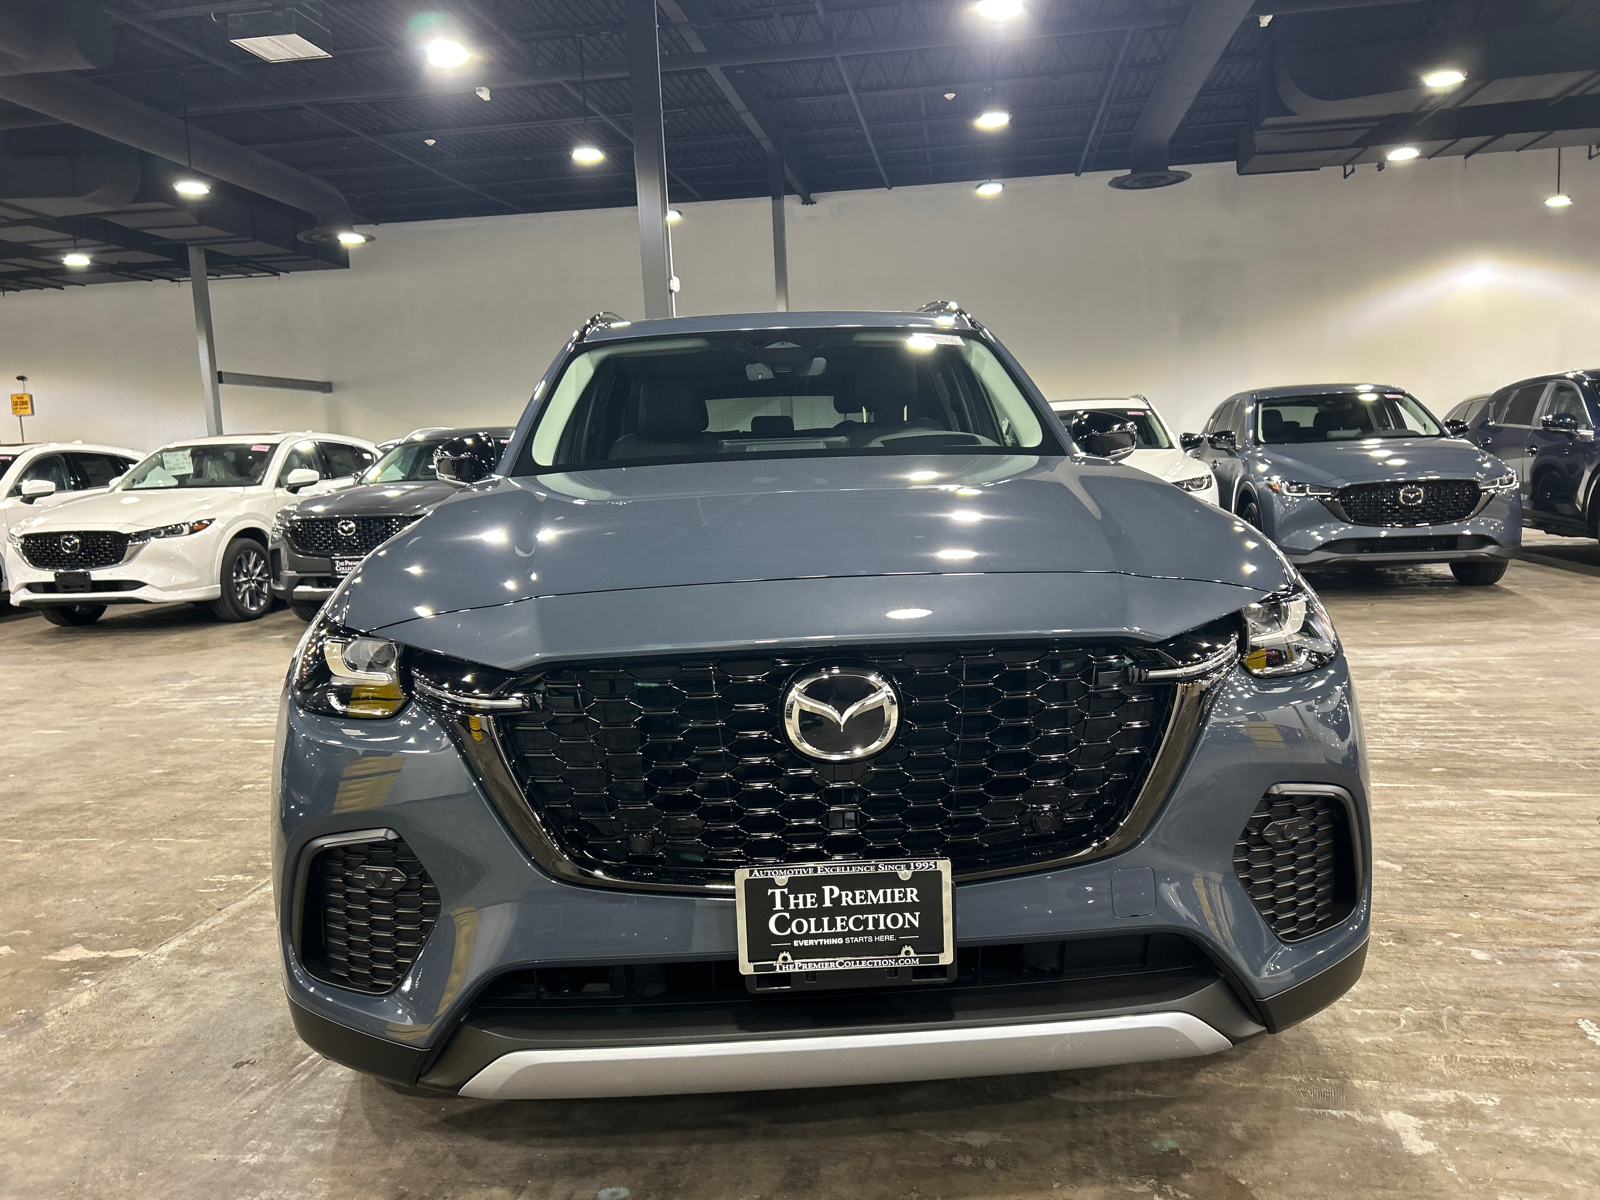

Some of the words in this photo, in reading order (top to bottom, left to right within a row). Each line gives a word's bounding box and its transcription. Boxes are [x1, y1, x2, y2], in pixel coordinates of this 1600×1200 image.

[751, 868, 814, 878] AUTOMOTIVE
[817, 865, 876, 873] EXCELLENCE
[878, 863, 906, 872] SINCE
[910, 861, 936, 870] 1995
[767, 888, 818, 911] THE
[822, 885, 920, 907] PREMIER
[768, 911, 921, 936] COLLECTION
[793, 937, 844, 947] EVERYTHING
[845, 935, 873, 944] STARTS
[773, 958, 920, 972] THEPREMIERCOLLECTION.COM
